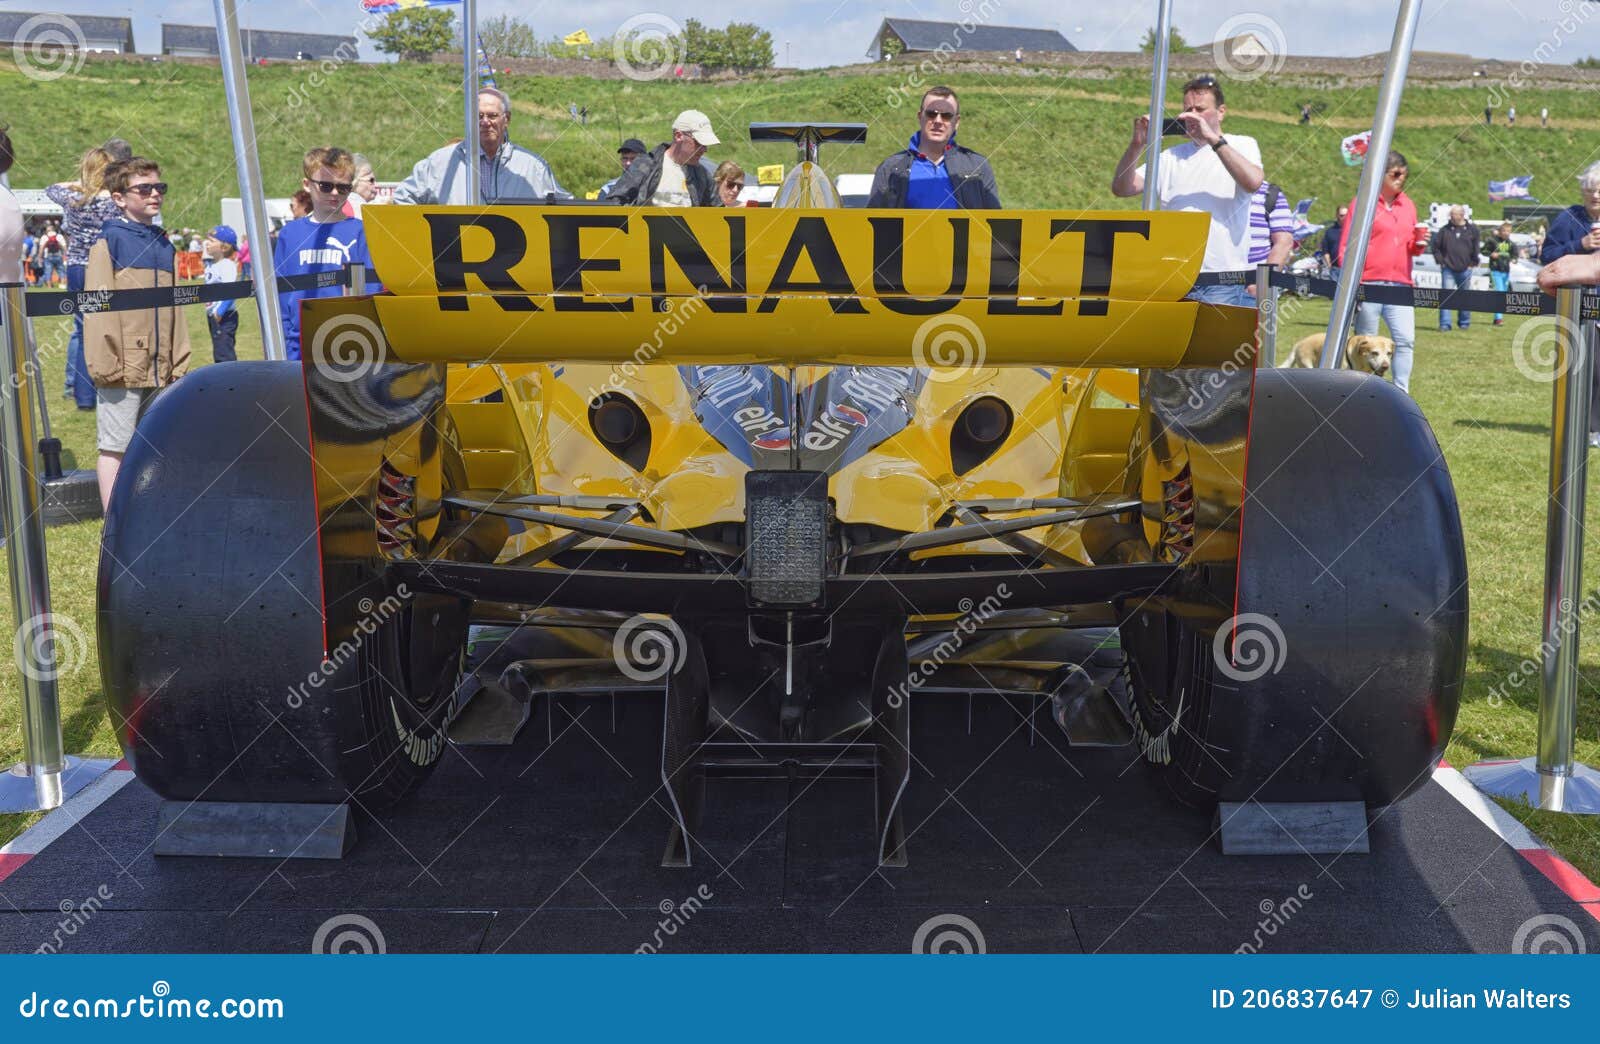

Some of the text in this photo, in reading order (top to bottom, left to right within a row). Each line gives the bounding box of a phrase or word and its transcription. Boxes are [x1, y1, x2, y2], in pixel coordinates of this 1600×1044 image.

[299, 249, 342, 266] PUMA
[423, 213, 1150, 316] RENAULT
[173, 287, 200, 297] RENAULT
[1413, 289, 1439, 300] RENAULT
[1505, 294, 1541, 306] RENAULT
[733, 407, 784, 432] elf
[804, 411, 852, 451] elf
